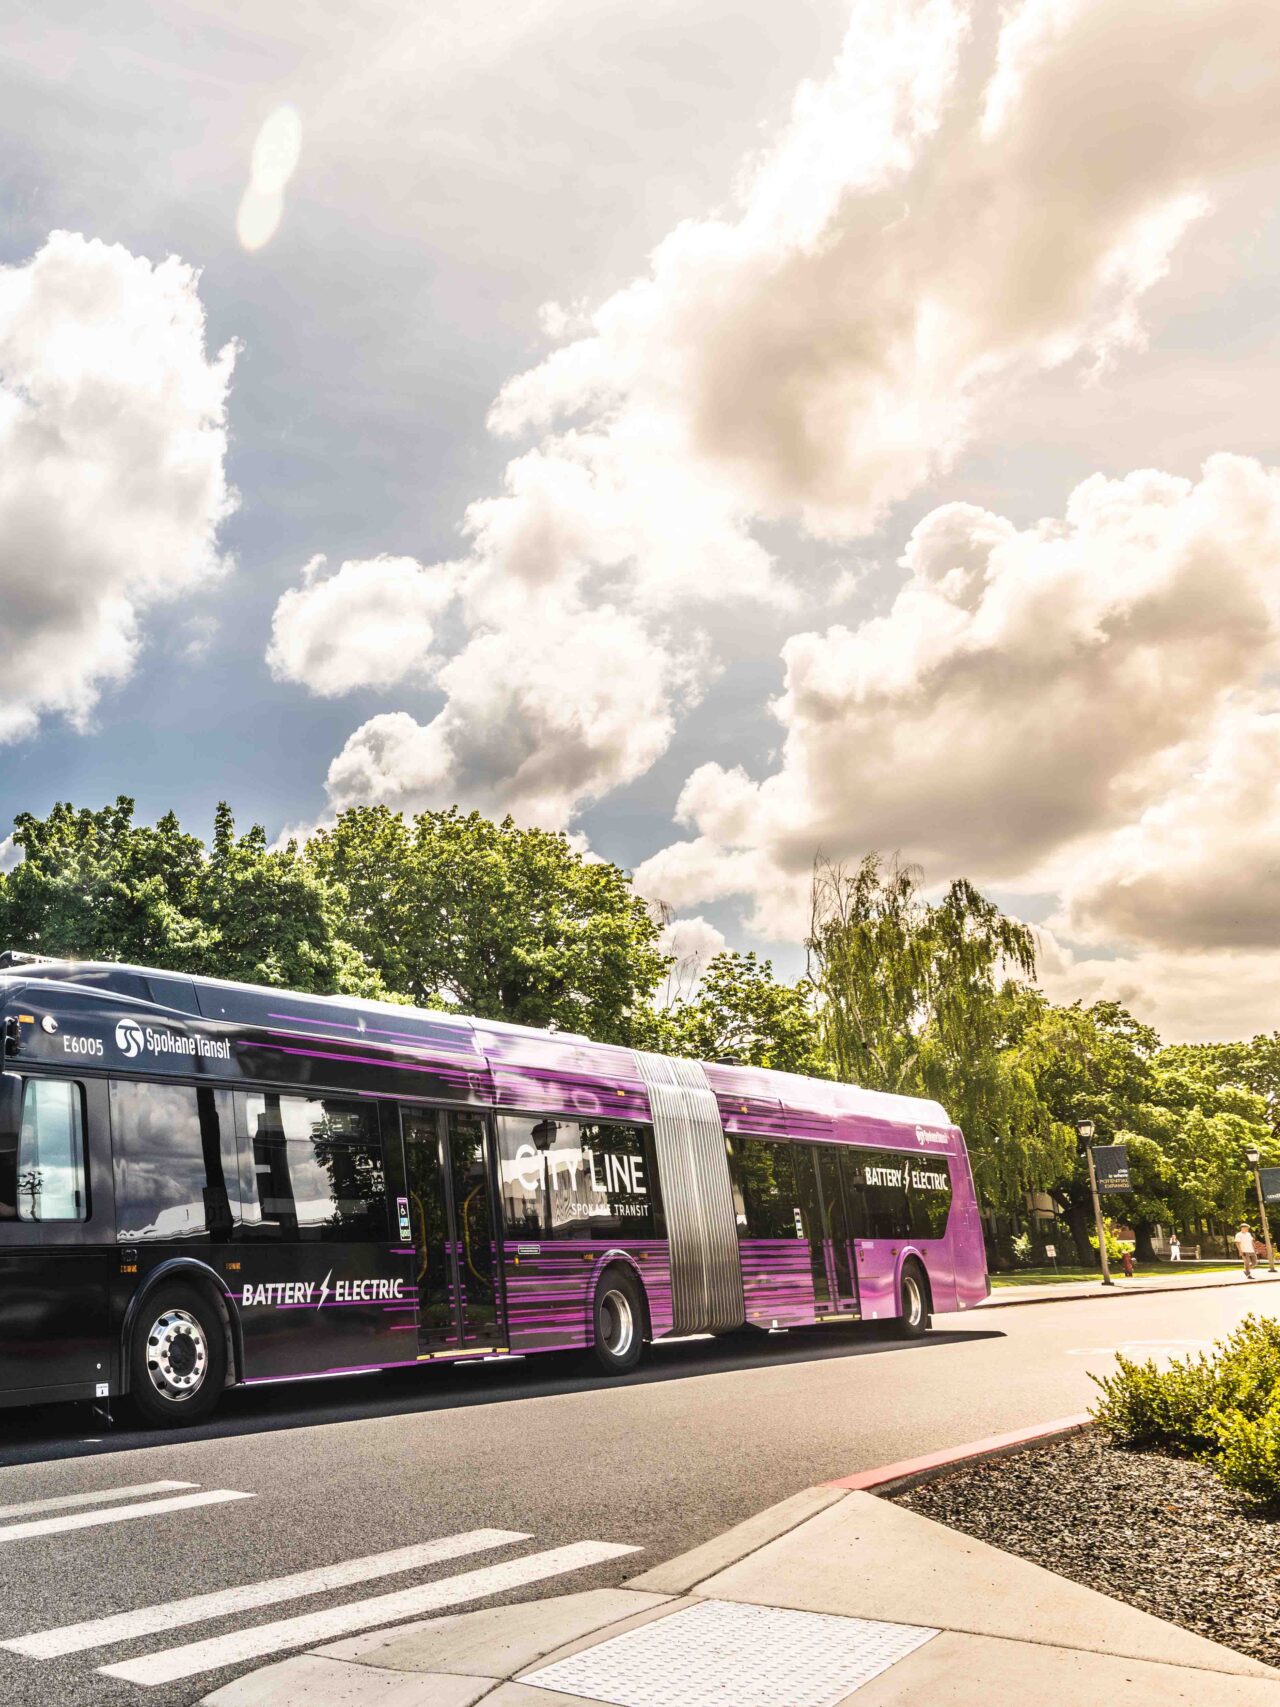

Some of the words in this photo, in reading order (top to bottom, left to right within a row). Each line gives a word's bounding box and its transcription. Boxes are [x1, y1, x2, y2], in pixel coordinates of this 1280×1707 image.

[63, 1035, 104, 1056] E6005
[588, 1149, 647, 1194] LINE
[865, 1166, 902, 1187] BATTERY
[911, 1170, 949, 1191] ELECTRIC
[614, 1203, 649, 1217] TRANSIT
[242, 1281, 315, 1306] BATTERY
[335, 1278, 404, 1302] ELECTRIC
